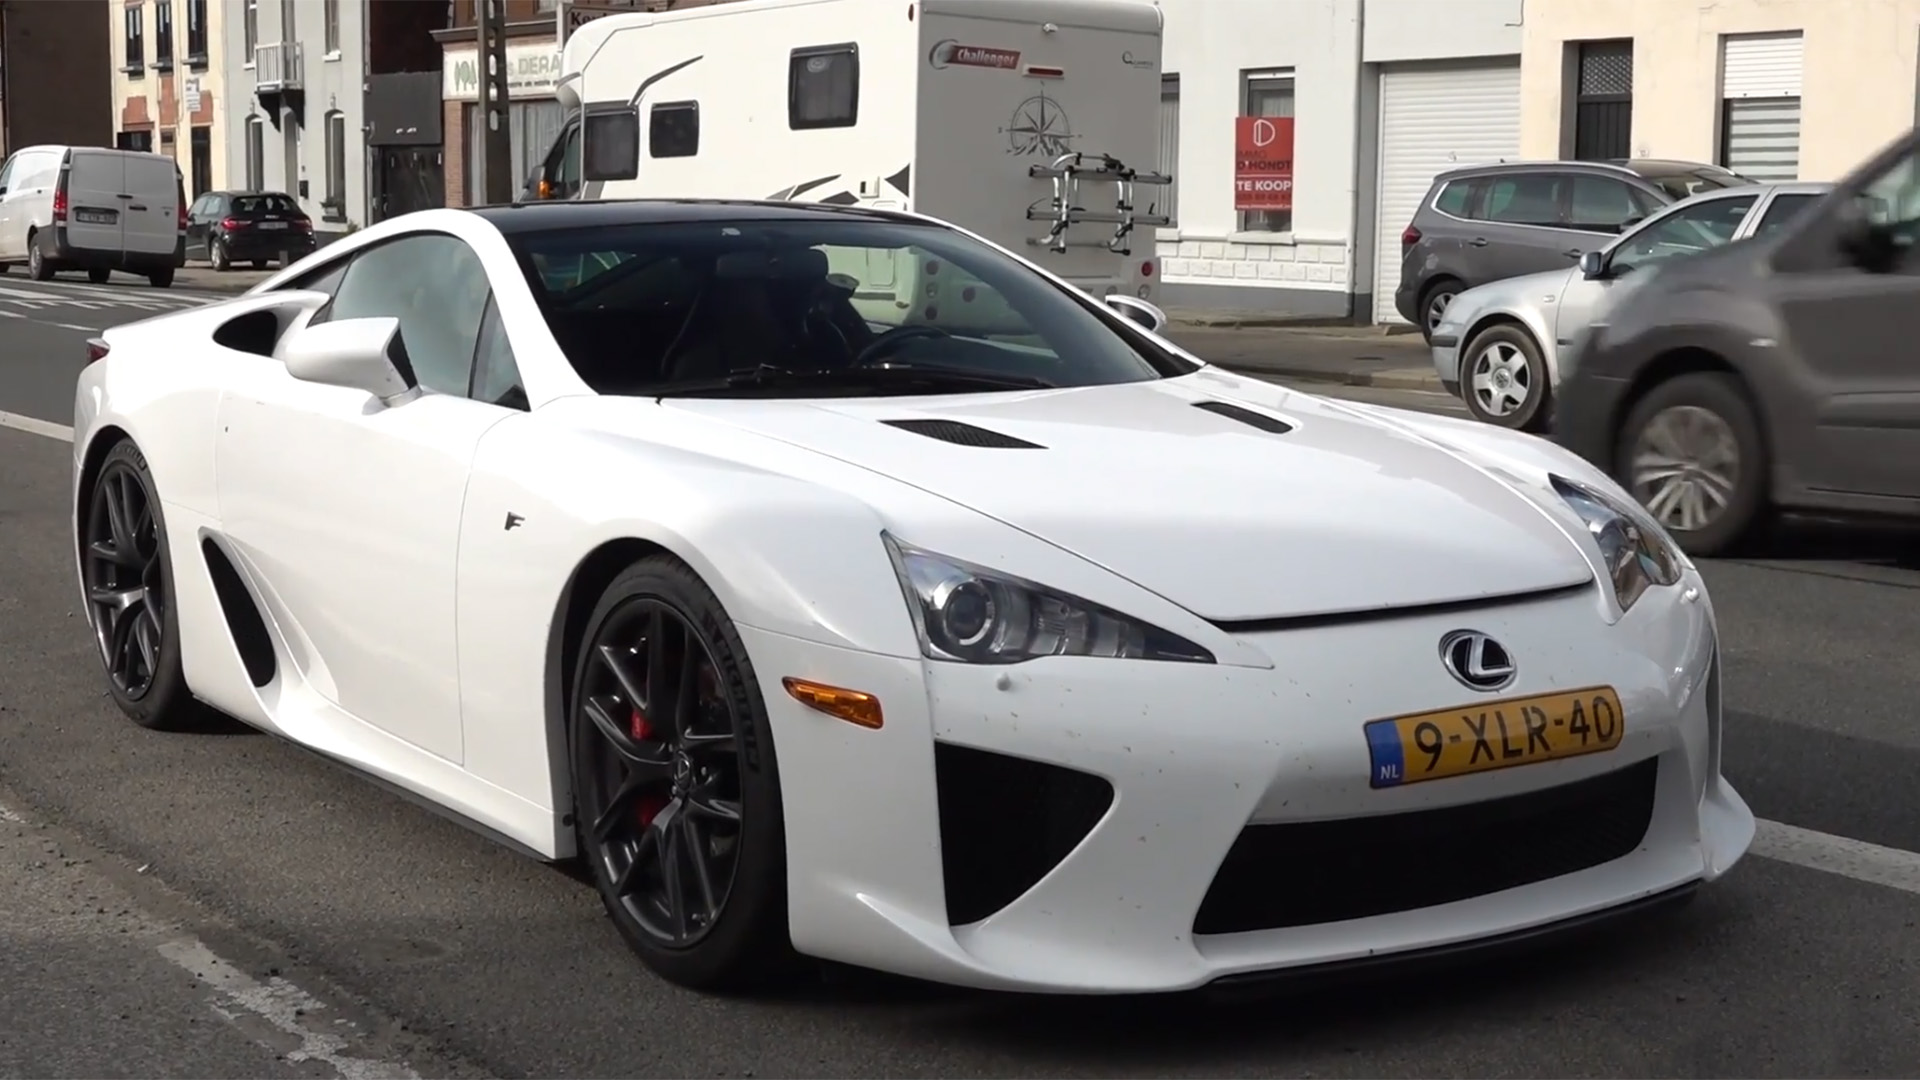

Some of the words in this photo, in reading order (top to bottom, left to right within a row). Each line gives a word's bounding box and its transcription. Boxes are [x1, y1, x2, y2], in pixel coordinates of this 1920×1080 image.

[957, 48, 1015, 67] Challenger
[1238, 160, 1292, 171] D'HONDT
[1237, 181, 1252, 191] TE
[1255, 180, 1292, 191] KOOP
[1414, 696, 1615, 772] 9-XLR-40
[1380, 766, 1399, 780] NL
